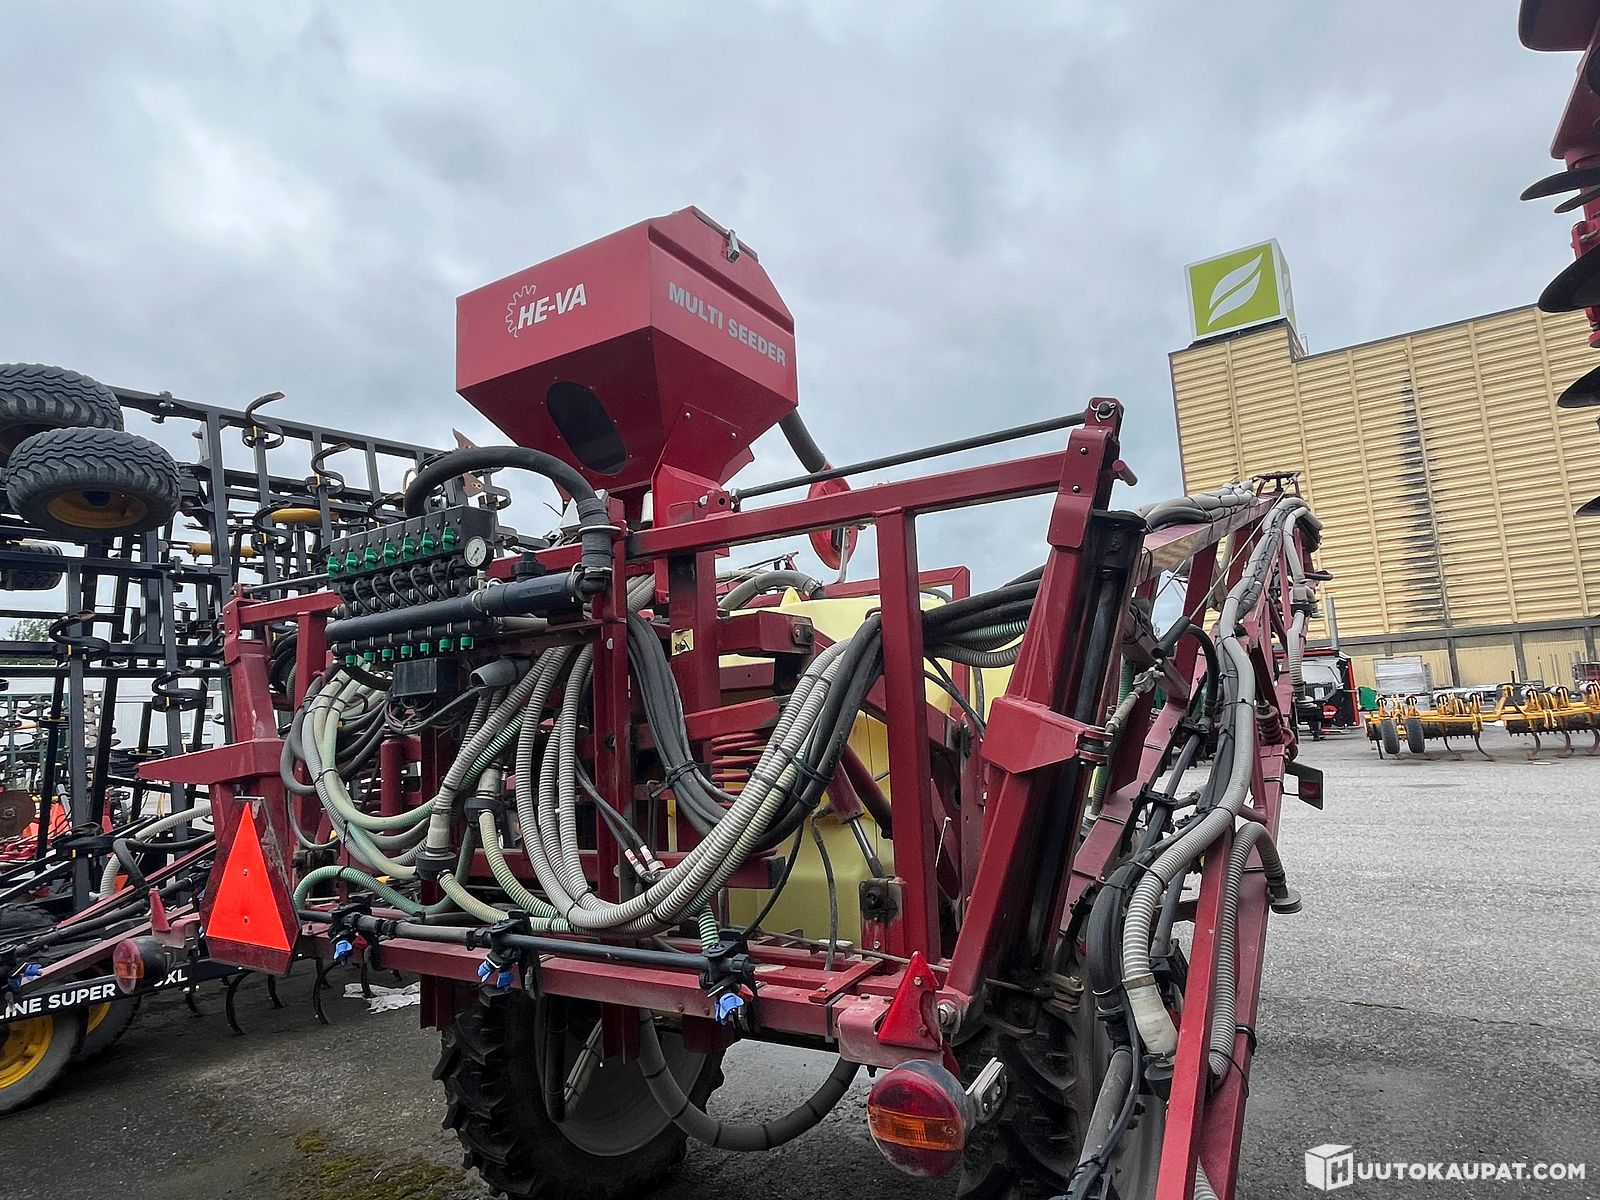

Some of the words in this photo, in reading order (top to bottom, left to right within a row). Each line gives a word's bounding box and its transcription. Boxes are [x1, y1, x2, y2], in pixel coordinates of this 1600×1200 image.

[517, 283, 587, 330] HE-VA
[668, 281, 724, 330] MULTI
[728, 318, 786, 368] SEEDER
[48, 983, 116, 1009] SUPER
